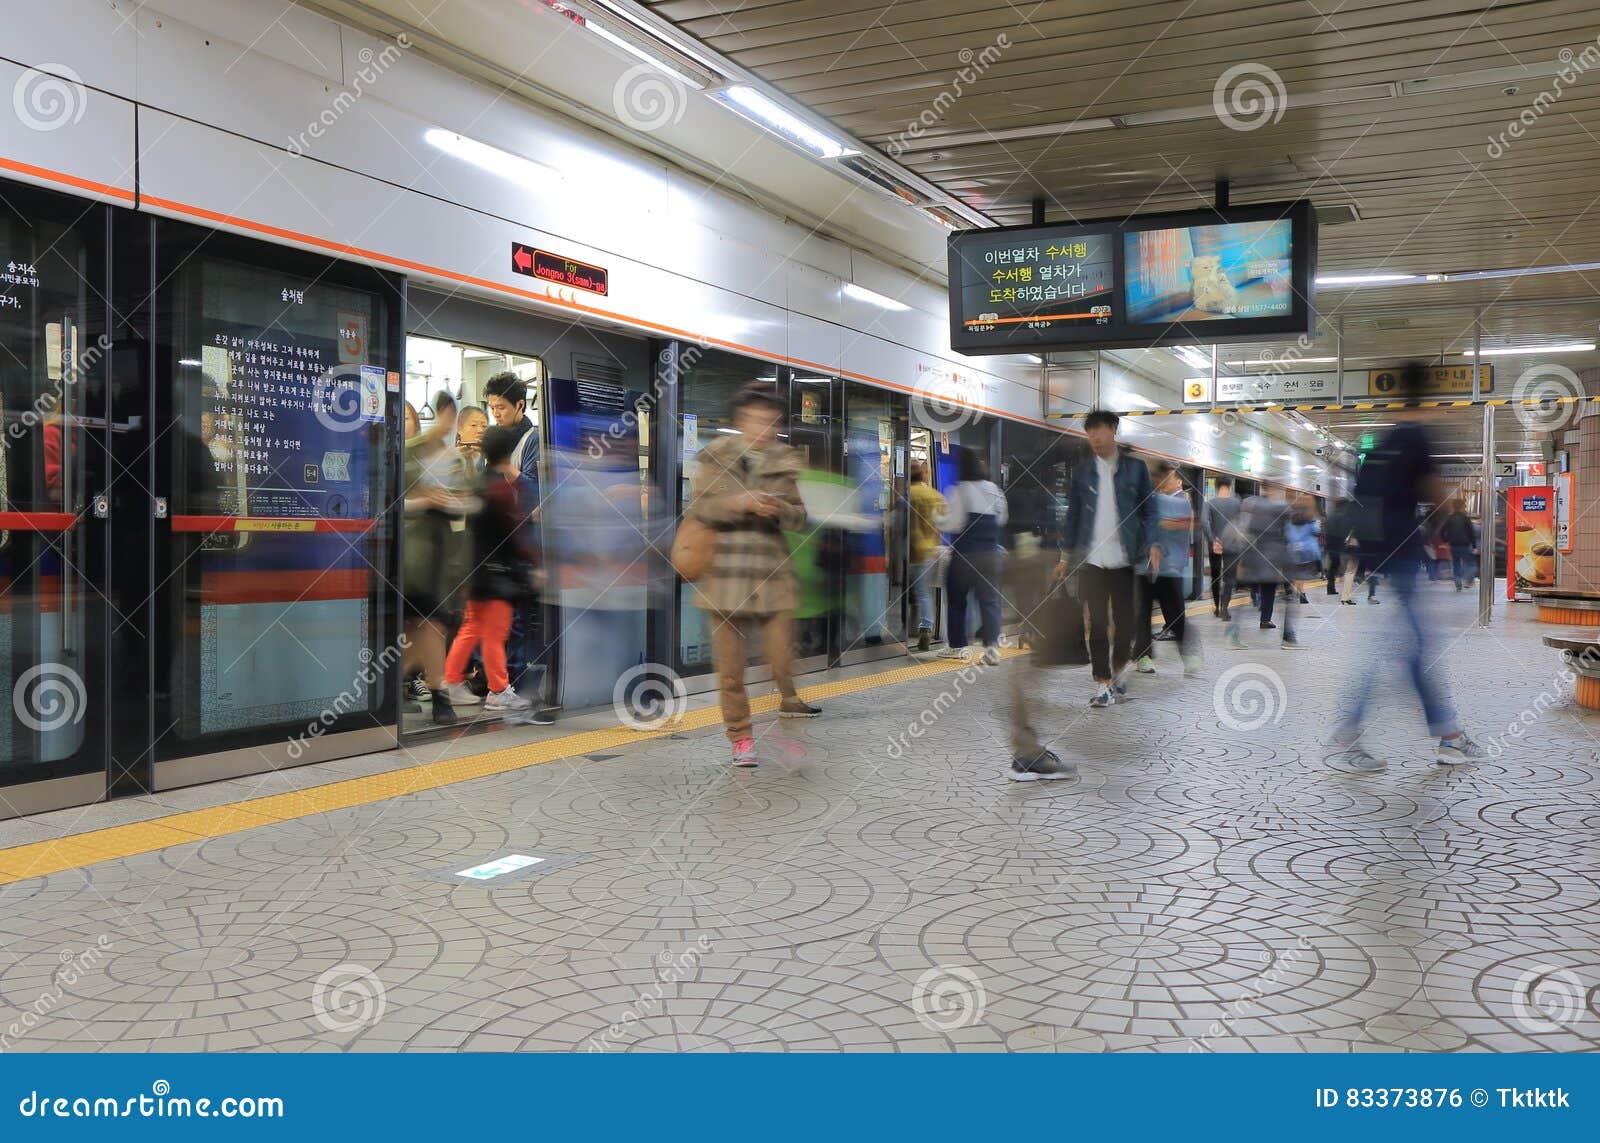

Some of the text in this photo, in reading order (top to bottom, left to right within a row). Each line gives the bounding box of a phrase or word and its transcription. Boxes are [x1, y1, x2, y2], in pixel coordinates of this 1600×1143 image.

[985, 242, 1087, 264] 이번열차 수서행
[7, 261, 37, 276] 송지수
[536, 264, 564, 281] Jongno
[564, 260, 577, 273] For
[992, 264, 1081, 284] 수서행 열차가
[281, 288, 304, 305] 숲처럼
[989, 282, 1086, 303] 도착하였습니다
[1191, 383, 1202, 397] 3
[1284, 380, 1299, 389] 수서
